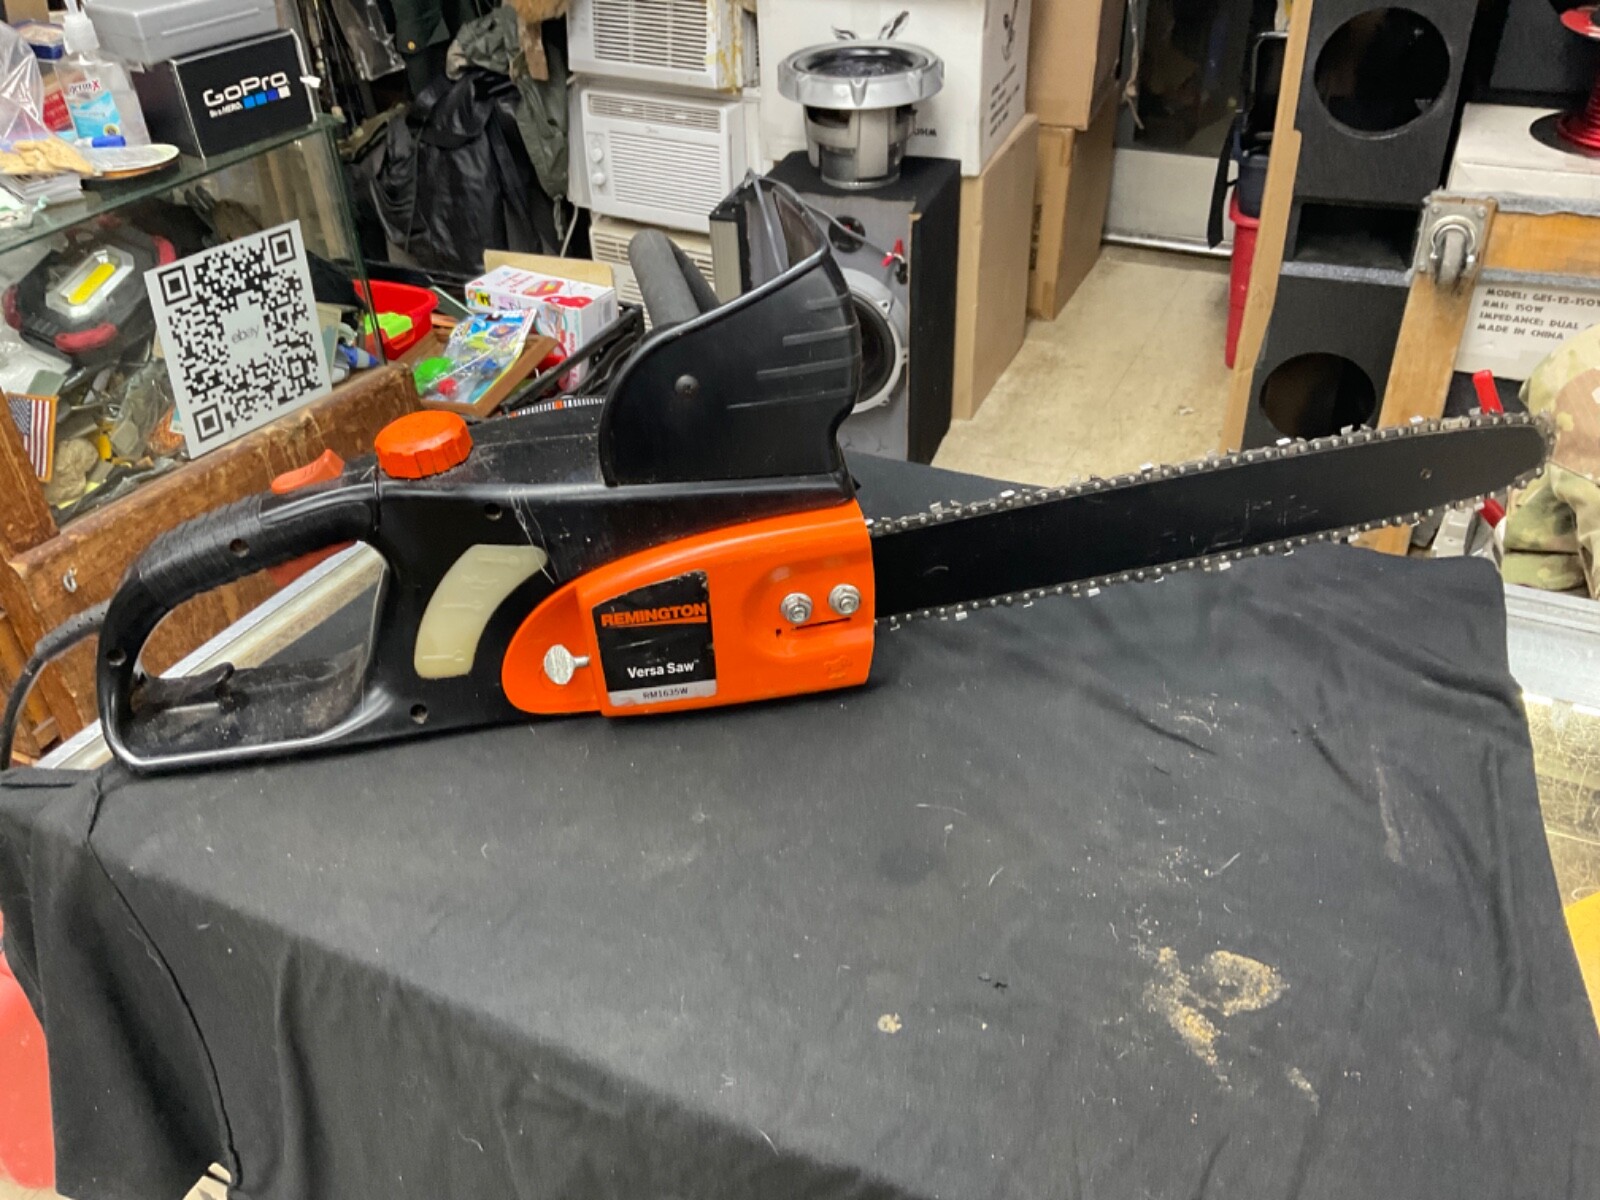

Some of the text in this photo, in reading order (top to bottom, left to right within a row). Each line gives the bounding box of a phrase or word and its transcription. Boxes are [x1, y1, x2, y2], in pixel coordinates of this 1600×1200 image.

[203, 72, 287, 107] GoPro
[1486, 288, 1527, 299] MODEL:
[1479, 310, 1579, 330] IMPEDANCE: DUAL
[231, 324, 260, 344] ebay
[1477, 323, 1565, 340] MADE IN CHINA
[601, 603, 707, 626] REMINGTON
[627, 665, 664, 679] Versa
[643, 687, 688, 699] RM1635W
